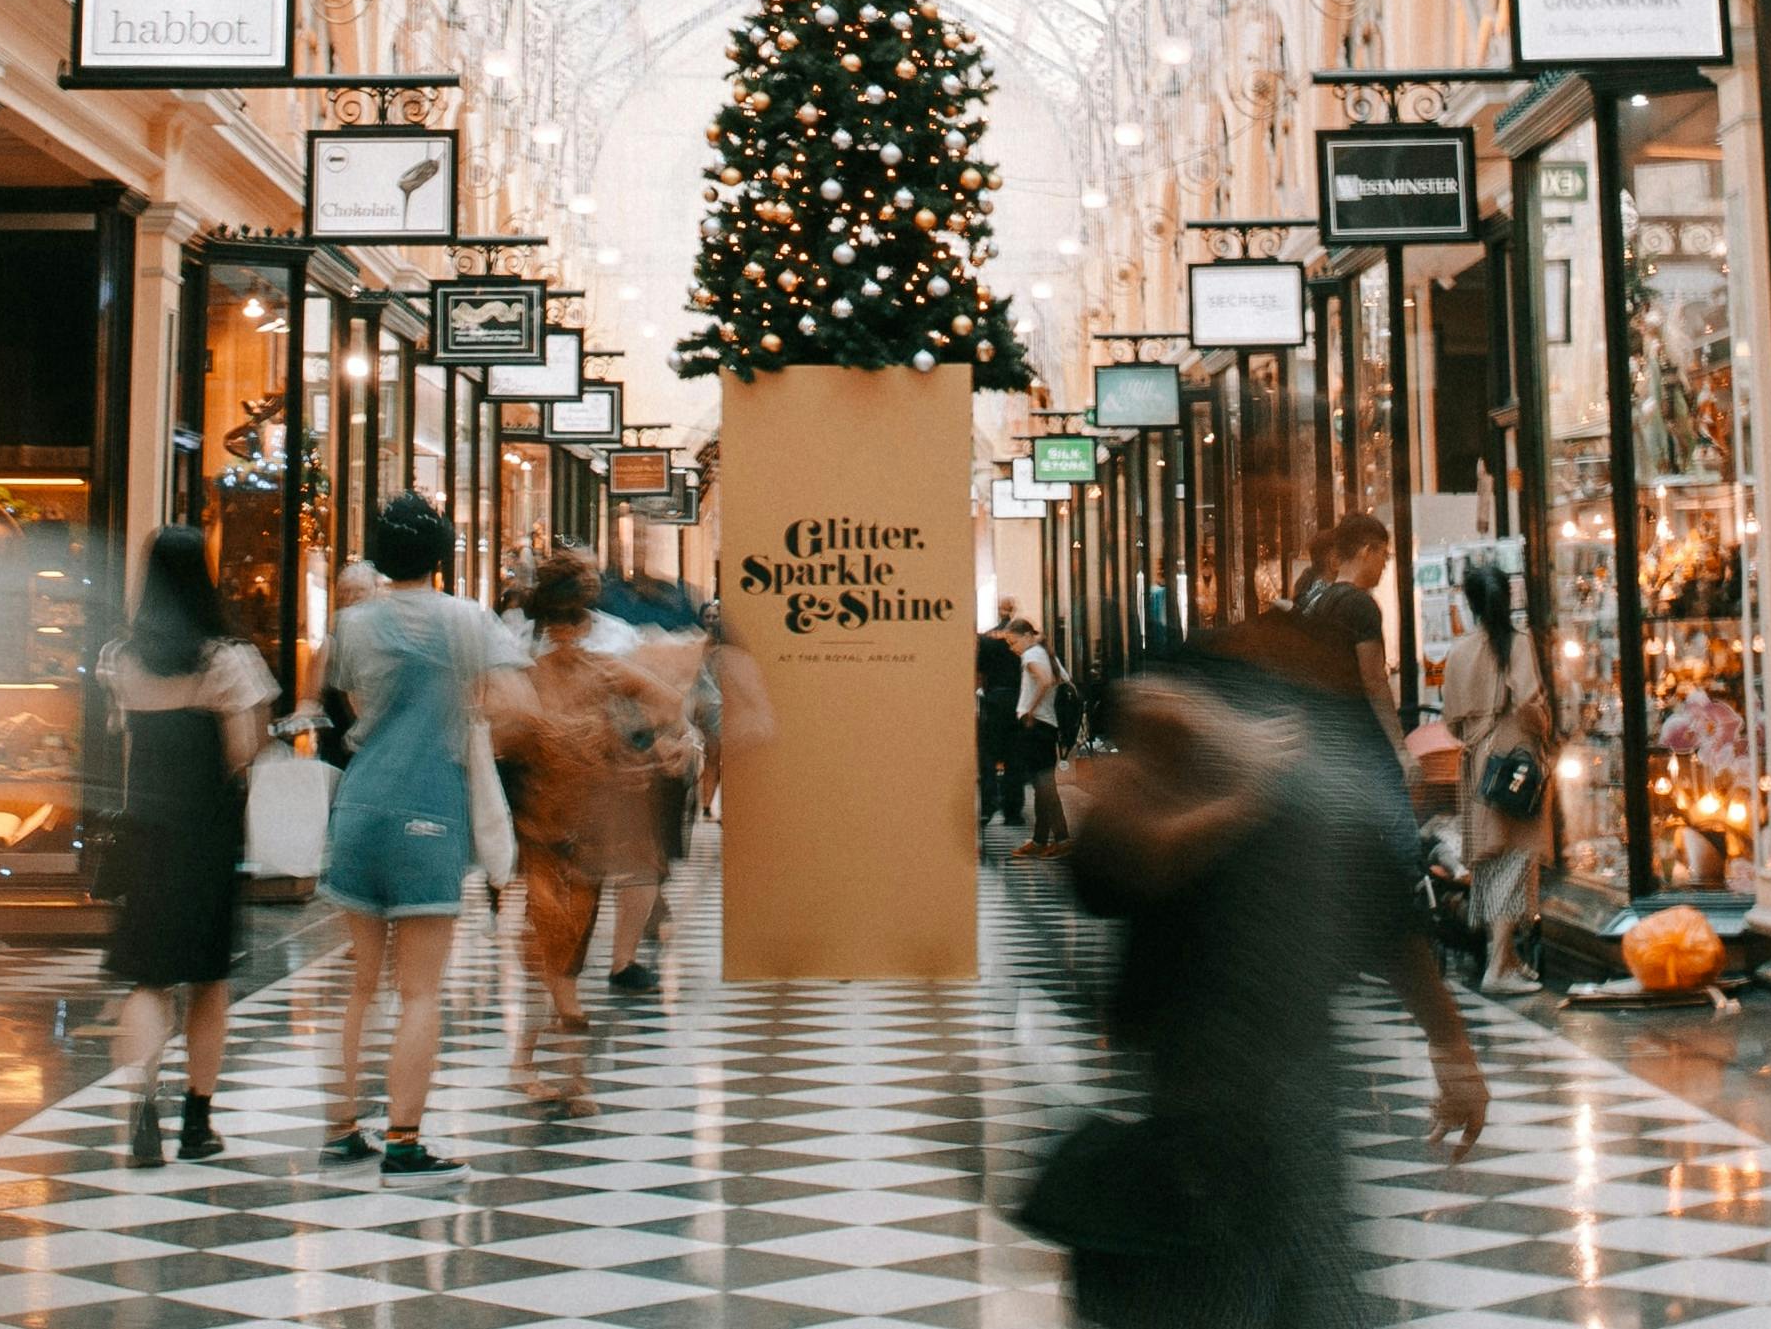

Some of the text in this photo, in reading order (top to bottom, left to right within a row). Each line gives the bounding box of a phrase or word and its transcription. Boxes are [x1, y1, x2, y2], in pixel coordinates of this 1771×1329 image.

[109, 9, 258, 45] habbot.
[784, 517, 926, 559] Glitter.
[739, 554, 895, 596] Sparkle
